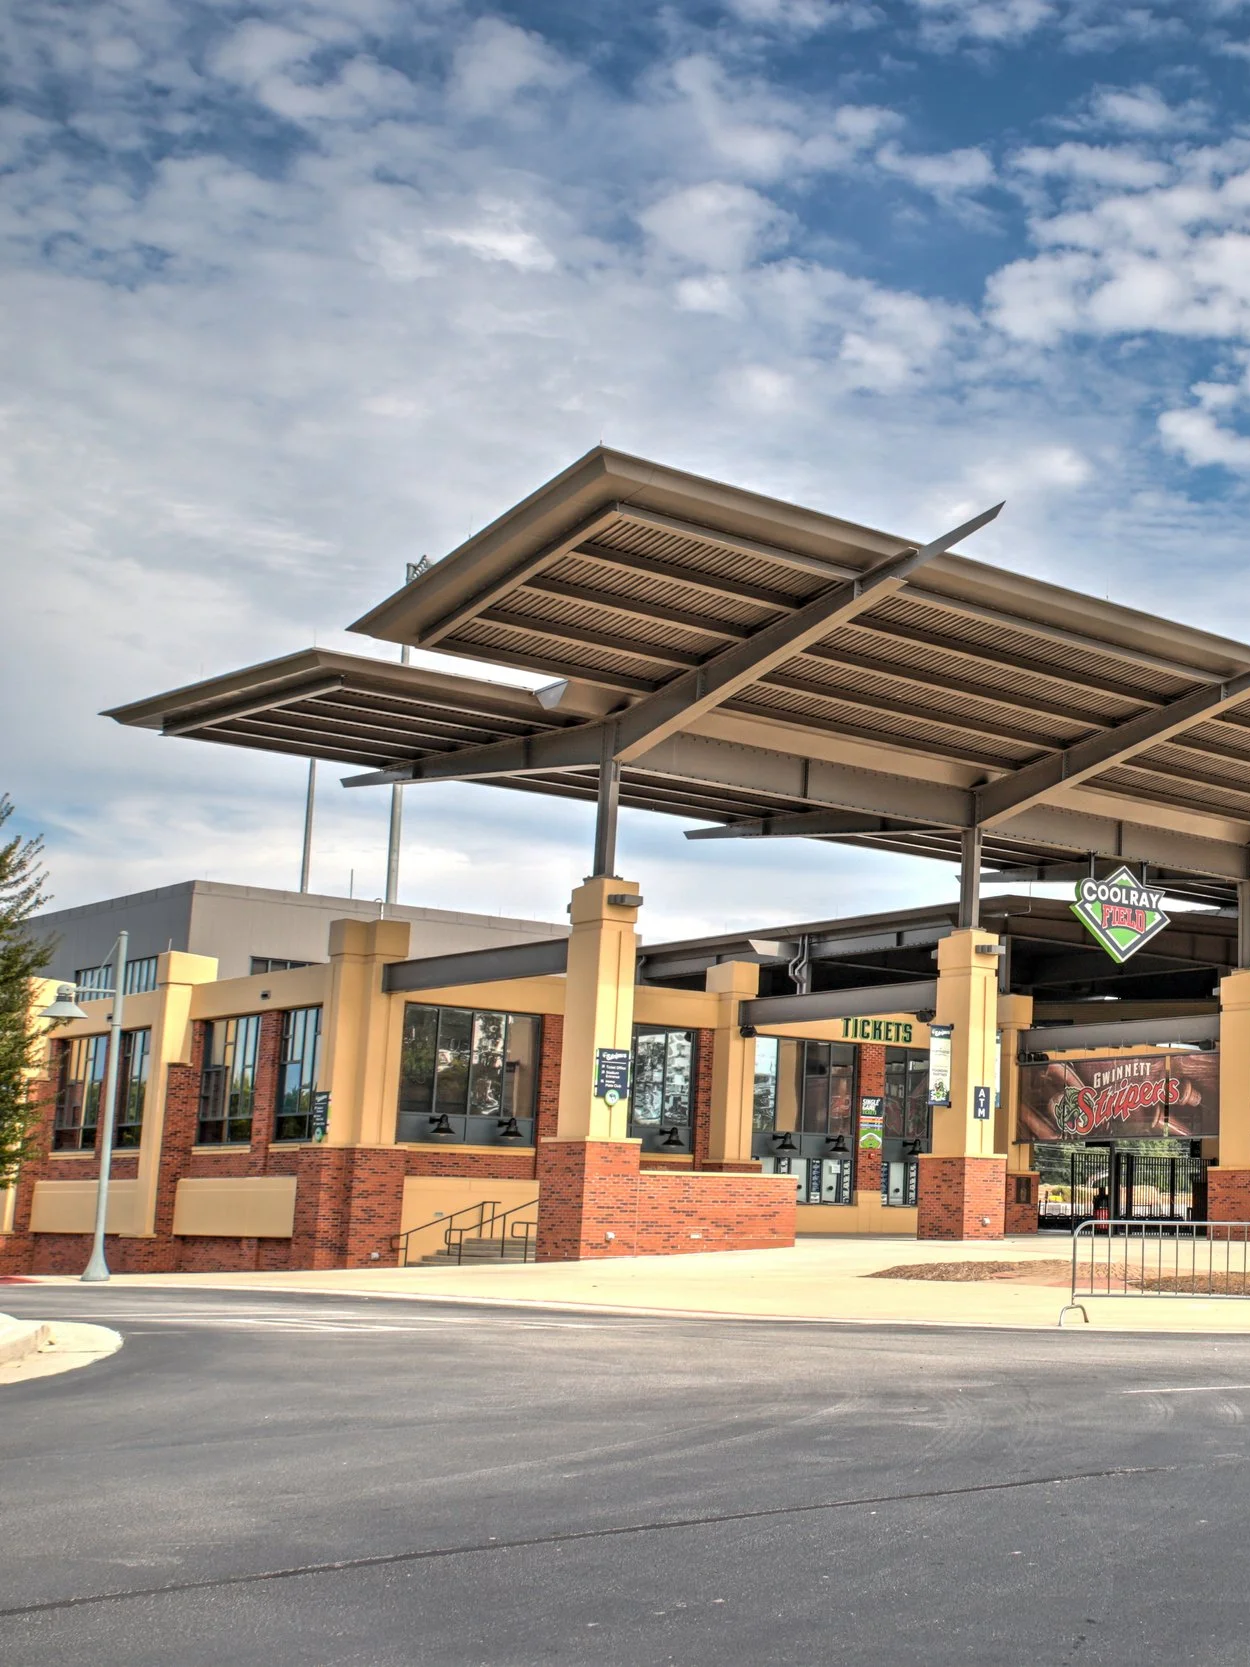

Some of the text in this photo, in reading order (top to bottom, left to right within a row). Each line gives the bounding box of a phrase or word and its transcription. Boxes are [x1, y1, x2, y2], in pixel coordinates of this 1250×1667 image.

[1083, 881, 1160, 909] COOLRAY
[1102, 903, 1146, 934] FIELD
[842, 1017, 912, 1043] TICKETS
[1093, 1062, 1151, 1089] GWINNETT
[978, 1088, 986, 1118] ATM
[1075, 1078, 1180, 1136] Stripers
